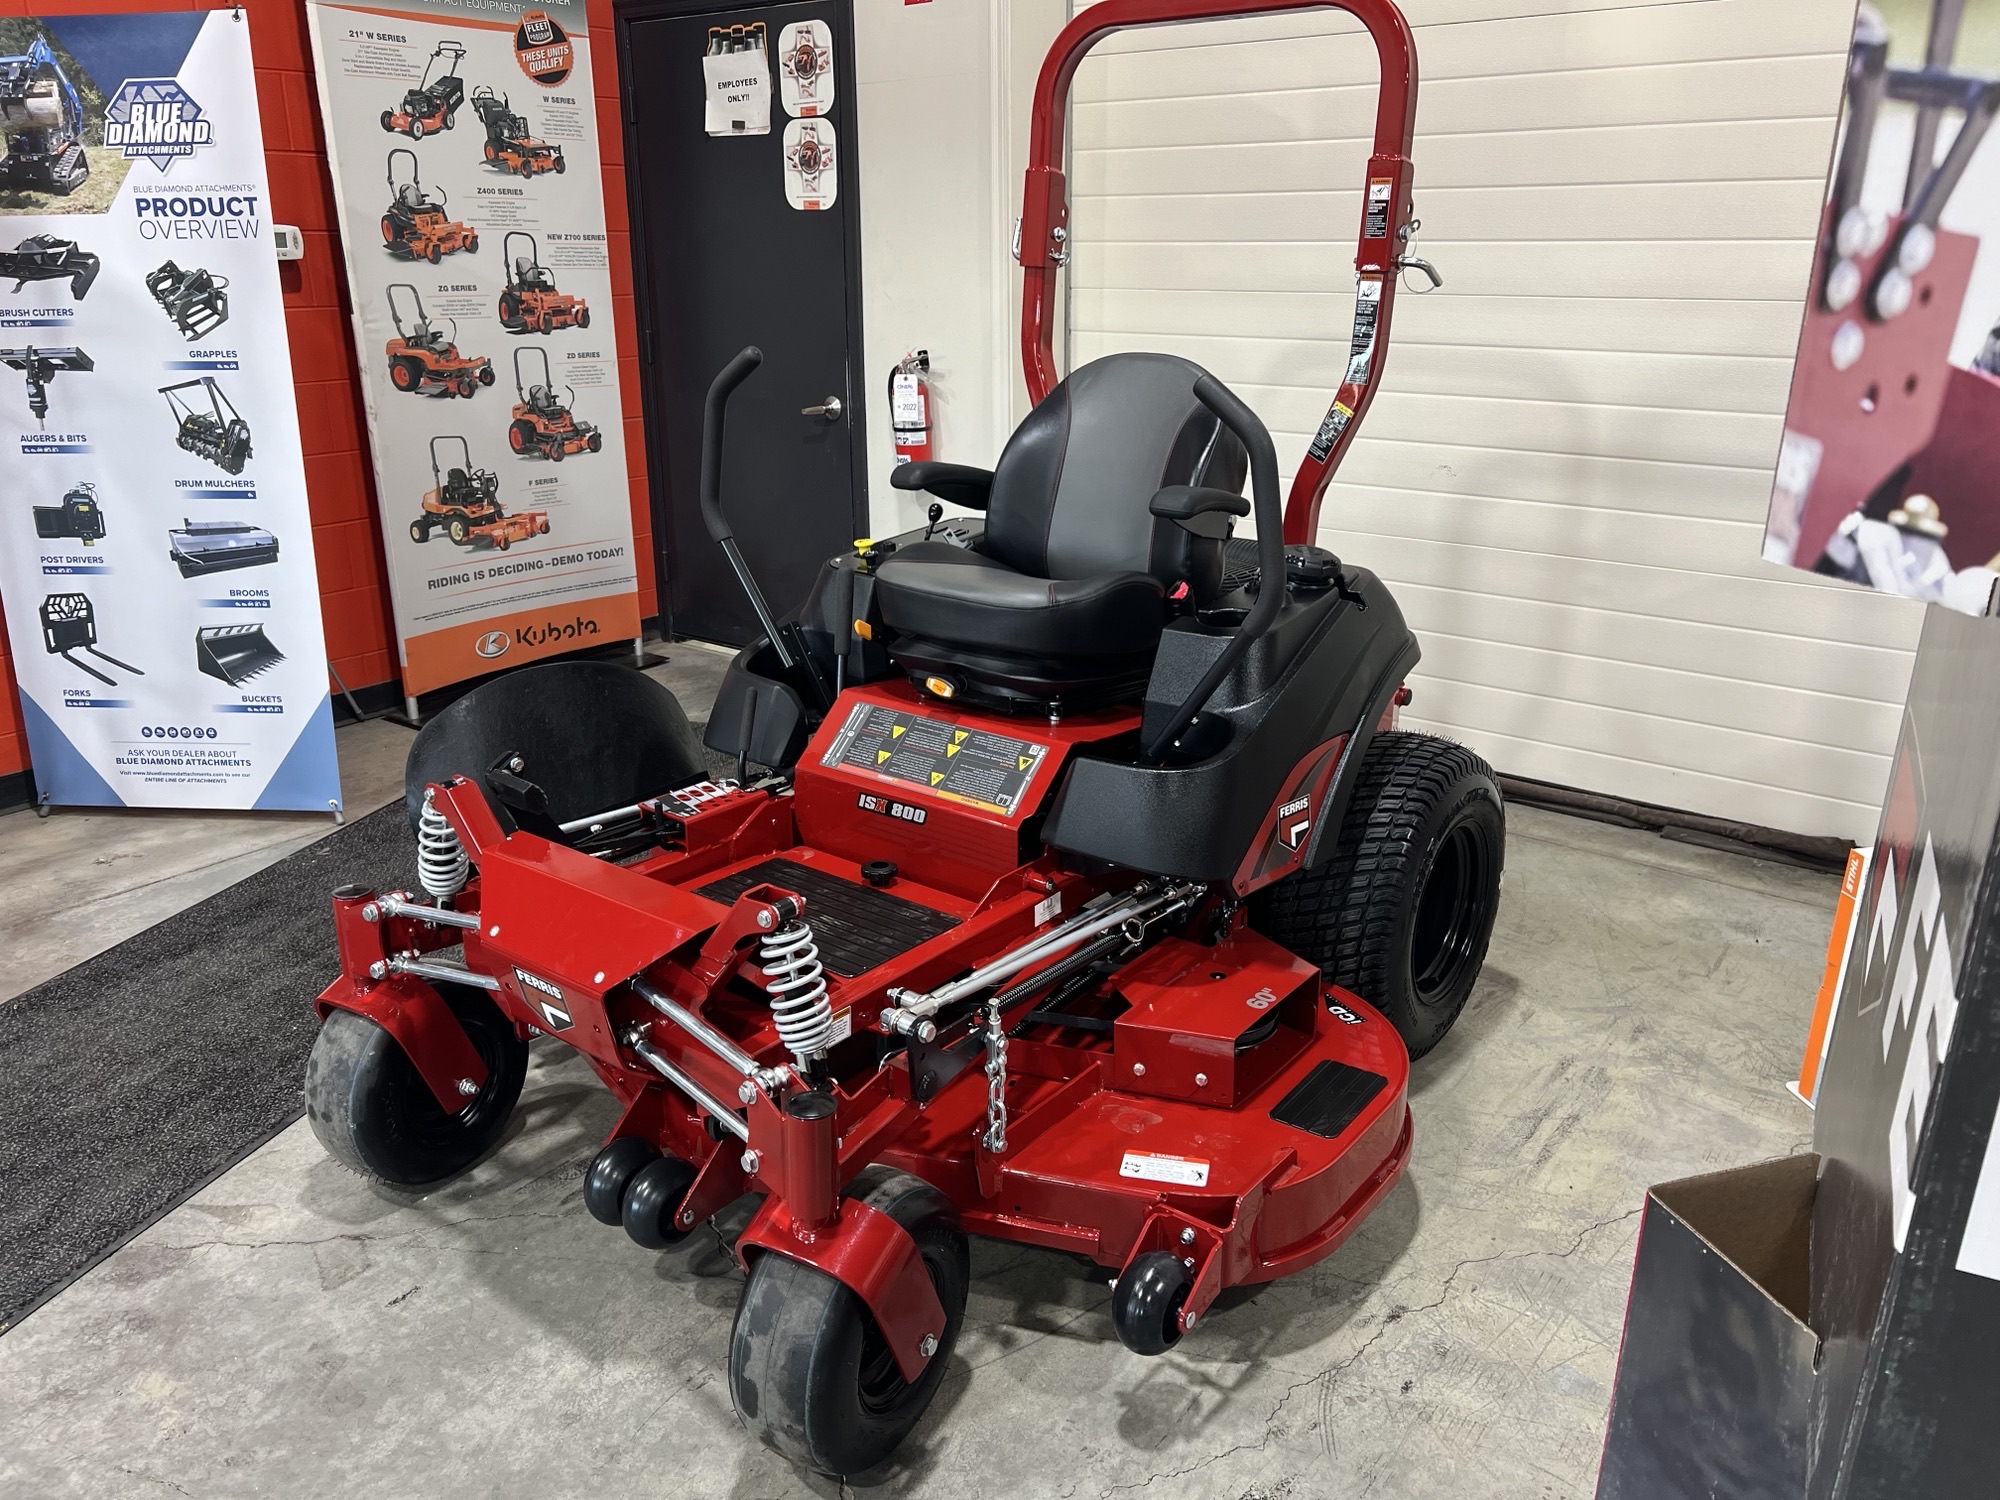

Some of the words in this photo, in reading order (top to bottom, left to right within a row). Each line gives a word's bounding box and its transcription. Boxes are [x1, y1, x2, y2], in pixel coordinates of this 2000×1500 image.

[527, 22, 548, 32] FLEET
[349, 30, 363, 38] 21"
[376, 33, 407, 43] SERIES
[522, 50, 545, 62] THESE
[548, 46, 568, 58] UNITS
[530, 56, 564, 72] QUALIFY
[718, 78, 758, 90] EMPLOYEES
[551, 96, 576, 104] SERIES
[728, 94, 750, 103] ONLY!!
[131, 102, 182, 124] BLUE
[108, 122, 210, 144] DIAMOND
[126, 145, 192, 155] ATTACHMENTS
[155, 185, 193, 193] DIAMOND
[498, 188, 524, 196] SERIES
[136, 196, 258, 217] PRODUCT
[139, 219, 259, 240] OVERVIEW
[0, 309, 30, 317] BRUSH
[32, 308, 74, 316] CUTTERS
[189, 350, 238, 358] GRAPPLES
[175, 480, 203, 488] DRUM
[205, 480, 255, 488] MULCHERS
[535, 477, 558, 486] SERIES
[40, 556, 64, 564] POST
[66, 556, 104, 564] DRIVERS
[428, 573, 470, 590] RIDING
[474, 571, 485, 580] IS
[588, 547, 624, 561] TODAY!
[229, 589, 269, 597] BROOMS
[516, 616, 598, 646] Kubota
[63, 689, 91, 697] FORKS
[208, 750, 237, 758] ABOUT
[140, 758, 183, 766] DIAMOND
[858, 794, 888, 814] ISX
[891, 803, 926, 823] 800
[1280, 797, 1309, 819] FERRIS
[1846, 858, 1860, 894] STIHL
[515, 968, 562, 1000] FERRIS
